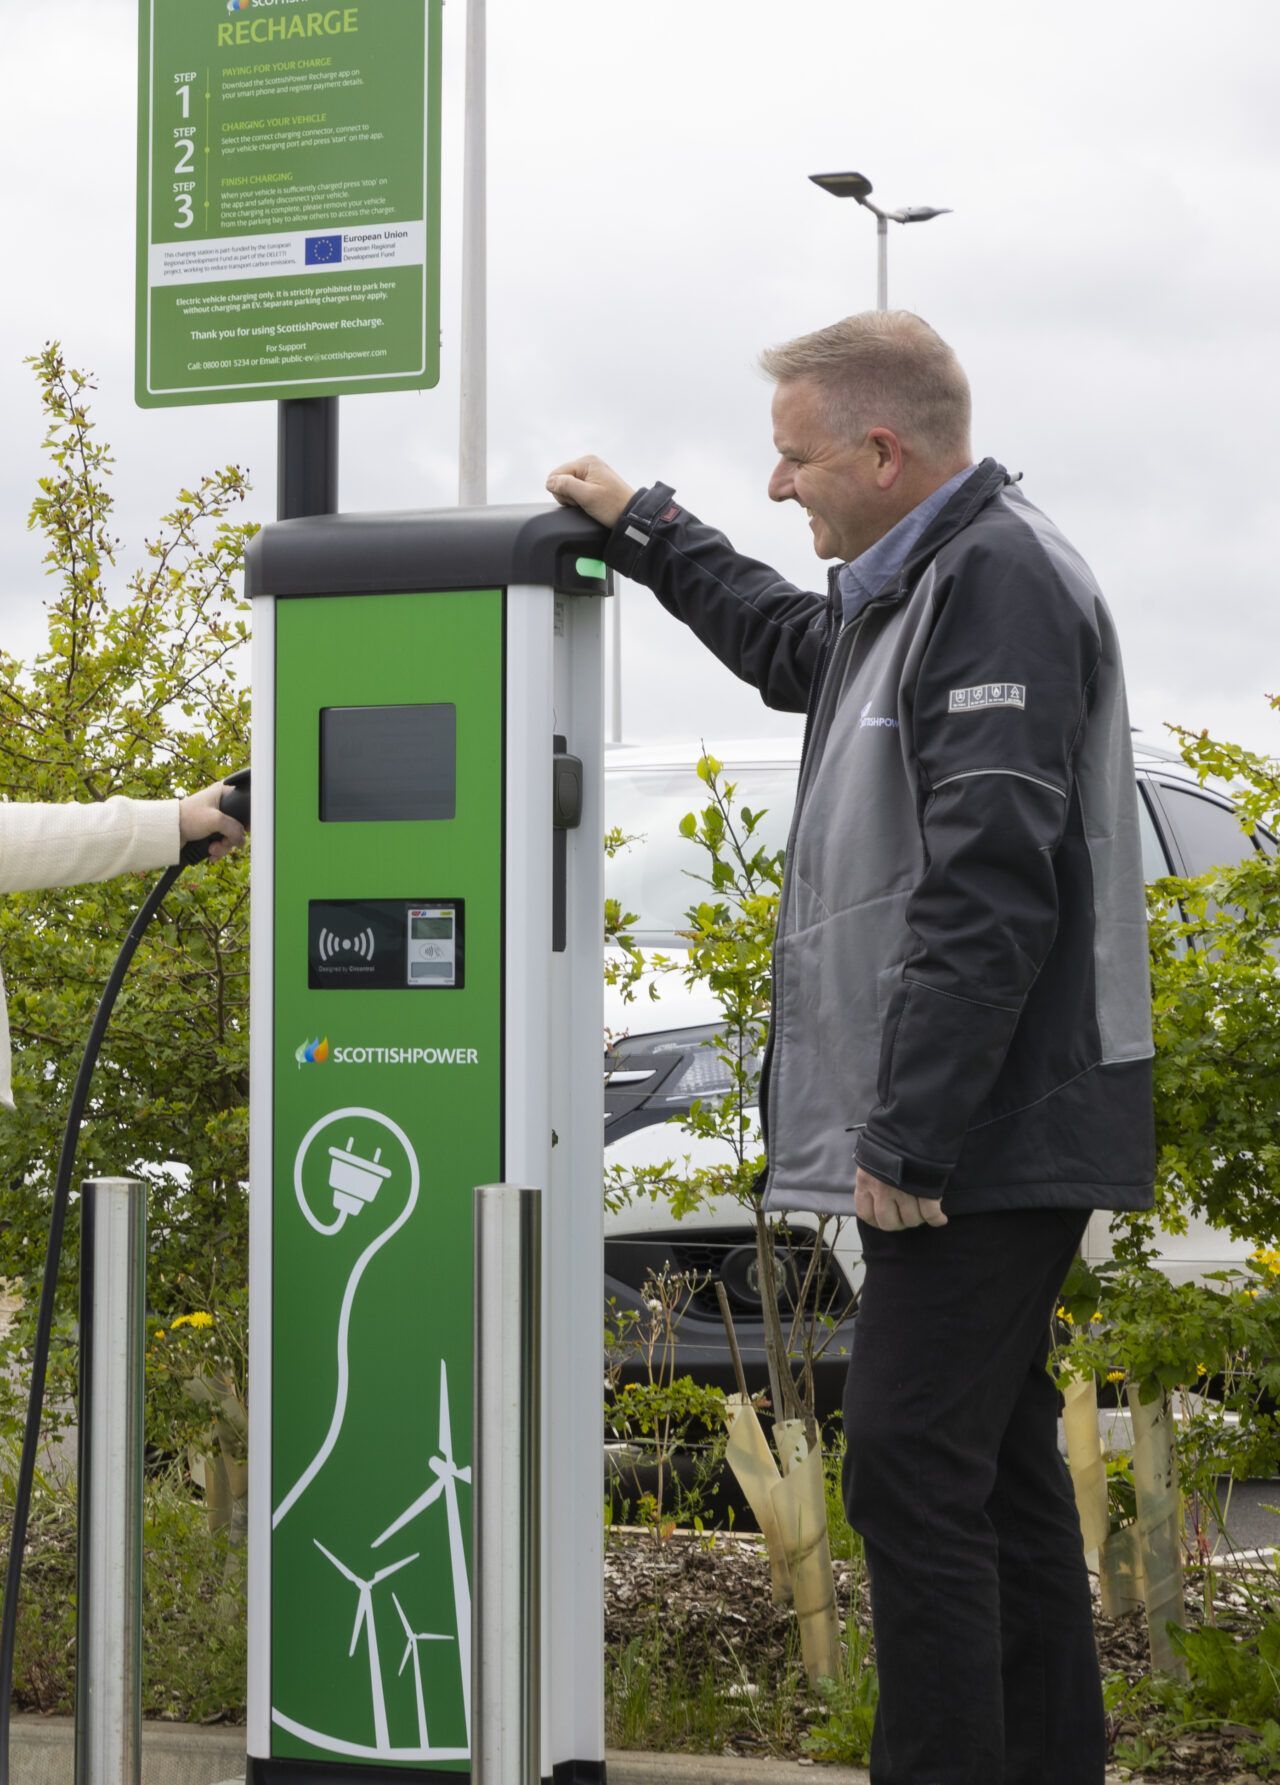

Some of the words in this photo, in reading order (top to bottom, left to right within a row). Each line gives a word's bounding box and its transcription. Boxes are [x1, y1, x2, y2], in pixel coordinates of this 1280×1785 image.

[217, 8, 359, 46] RECHARGE
[222, 66, 251, 77] PAYING
[254, 64, 270, 73] FOR
[273, 61, 295, 71] YOUR
[297, 57, 333, 69] CHARGE
[174, 72, 197, 83] STEP
[222, 80, 253, 89] Download
[265, 76, 307, 85] ScottishPower
[309, 73, 337, 81] Recharge
[222, 92, 235, 100] your
[237, 89, 254, 97] smart
[256, 88, 275, 97] phone
[277, 85, 288, 93] and
[289, 84, 312, 93] register
[313, 81, 341, 91] payment
[175, 84, 189, 118] 1
[221, 120, 264, 132] CHARGING
[267, 117, 290, 127] YOUR
[292, 113, 327, 125] VEHICLE
[174, 127, 196, 138] STEP
[221, 137, 239, 145] Select
[241, 135, 250, 143] the
[252, 134, 273, 142] correct
[275, 131, 301, 140] charging
[336, 125, 361, 134] connect
[221, 147, 235, 155] your
[237, 144, 257, 152] vehicle
[259, 142, 285, 150] charging
[286, 140, 299, 149] port
[301, 138, 312, 146] and
[314, 138, 330, 146] press
[174, 138, 194, 174] 2
[172, 181, 196, 192] STEP
[221, 177, 248, 187] FINISH
[250, 172, 294, 184] CHARGING
[174, 194, 194, 229] 3
[343, 234, 382, 243] European
[384, 231, 408, 239] Union
[372, 242, 396, 250] Regional
[343, 253, 380, 261] Development
[176, 297, 200, 306] Electric
[203, 295, 226, 304] vehicle
[228, 293, 257, 302] charging
[290, 288, 314, 297] strictly
[315, 285, 352, 297] prohibited
[362, 283, 378, 293] park
[183, 306, 209, 314] without
[211, 304, 240, 313] charging
[263, 300, 293, 309] Separate
[294, 298, 321, 307] parking
[322, 296, 349, 304] charges
[190, 329, 217, 340] Thank
[219, 330, 235, 340] you
[237, 328, 249, 337] for
[252, 326, 275, 337] using
[277, 322, 339, 334] ScottishPower
[341, 318, 384, 329] Recharge.
[279, 343, 307, 352] Support
[188, 362, 201, 370] Call:
[203, 361, 219, 369] 0800
[220, 360, 231, 368] 001
[234, 359, 249, 367] 5234
[260, 356, 280, 365] Email:
[333, 1047, 479, 1064] SCOTTISHPOWER
